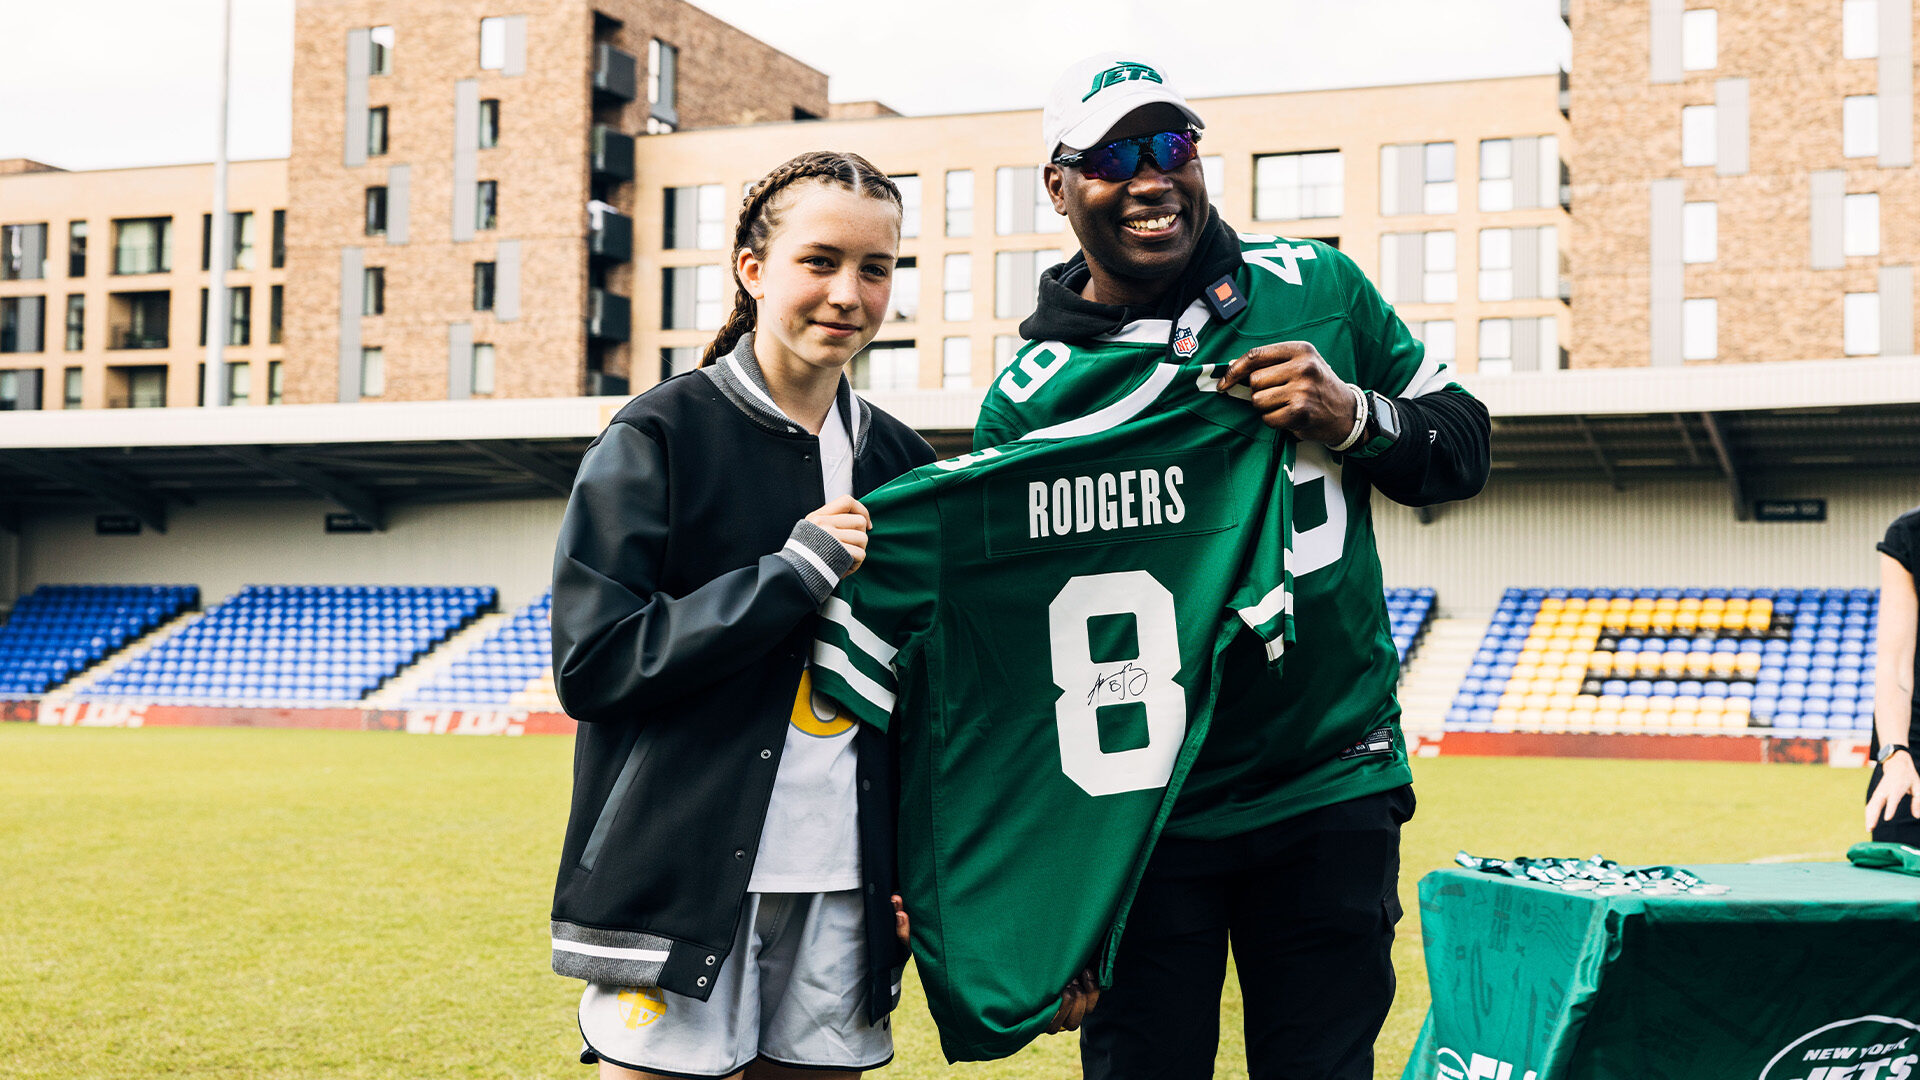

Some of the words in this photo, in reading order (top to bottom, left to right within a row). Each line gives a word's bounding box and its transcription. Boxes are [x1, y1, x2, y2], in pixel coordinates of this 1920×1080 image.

[1082, 62, 1163, 103] JETS
[1176, 337, 1196, 352] NFL
[997, 340, 1072, 403] 9
[1028, 465, 1186, 539] RODGERS
[1048, 569, 1187, 797] 8
[1803, 1047, 1857, 1061] NEW
[1859, 1037, 1910, 1059] YORK
